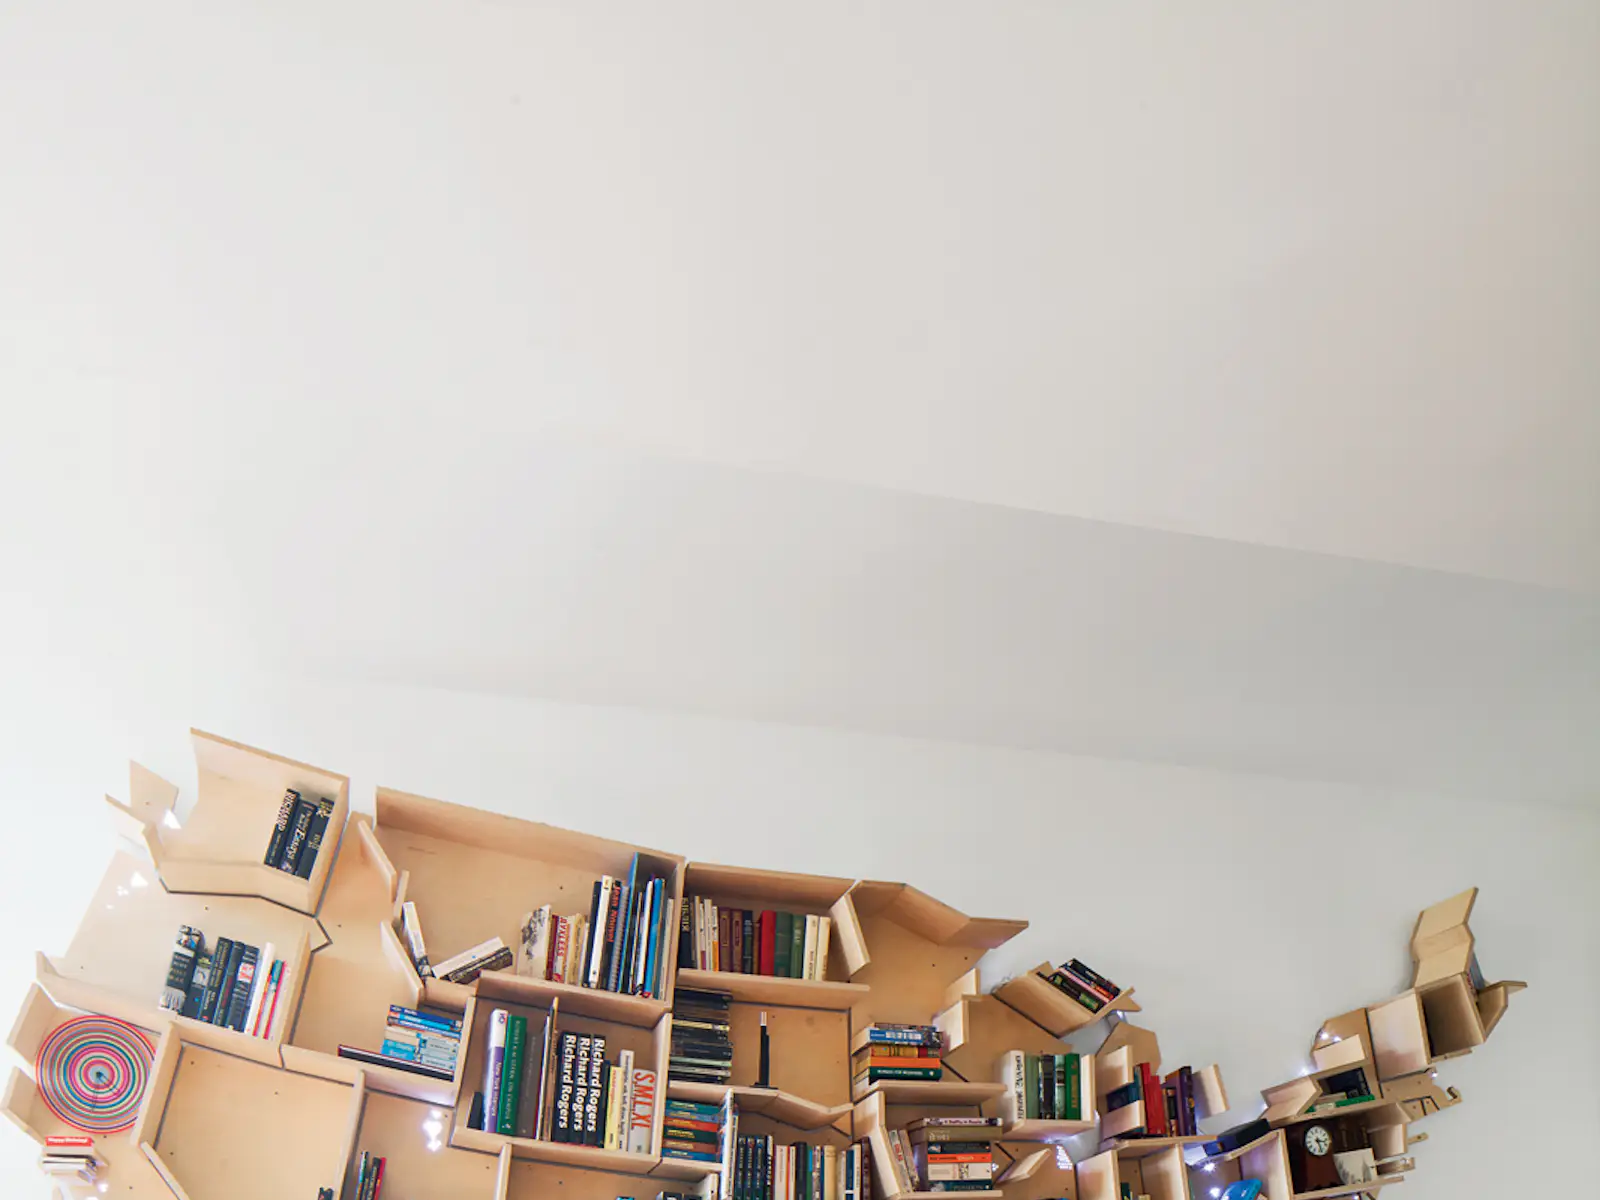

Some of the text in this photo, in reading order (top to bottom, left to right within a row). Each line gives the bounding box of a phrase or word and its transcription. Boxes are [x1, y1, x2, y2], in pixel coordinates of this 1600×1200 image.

[607, 886, 621, 943] Jean Nouvel
[559, 1035, 576, 1129] Richard Rogers
[574, 1037, 590, 1131] Richard Rogers
[587, 1039, 605, 1132] Richard Rogers
